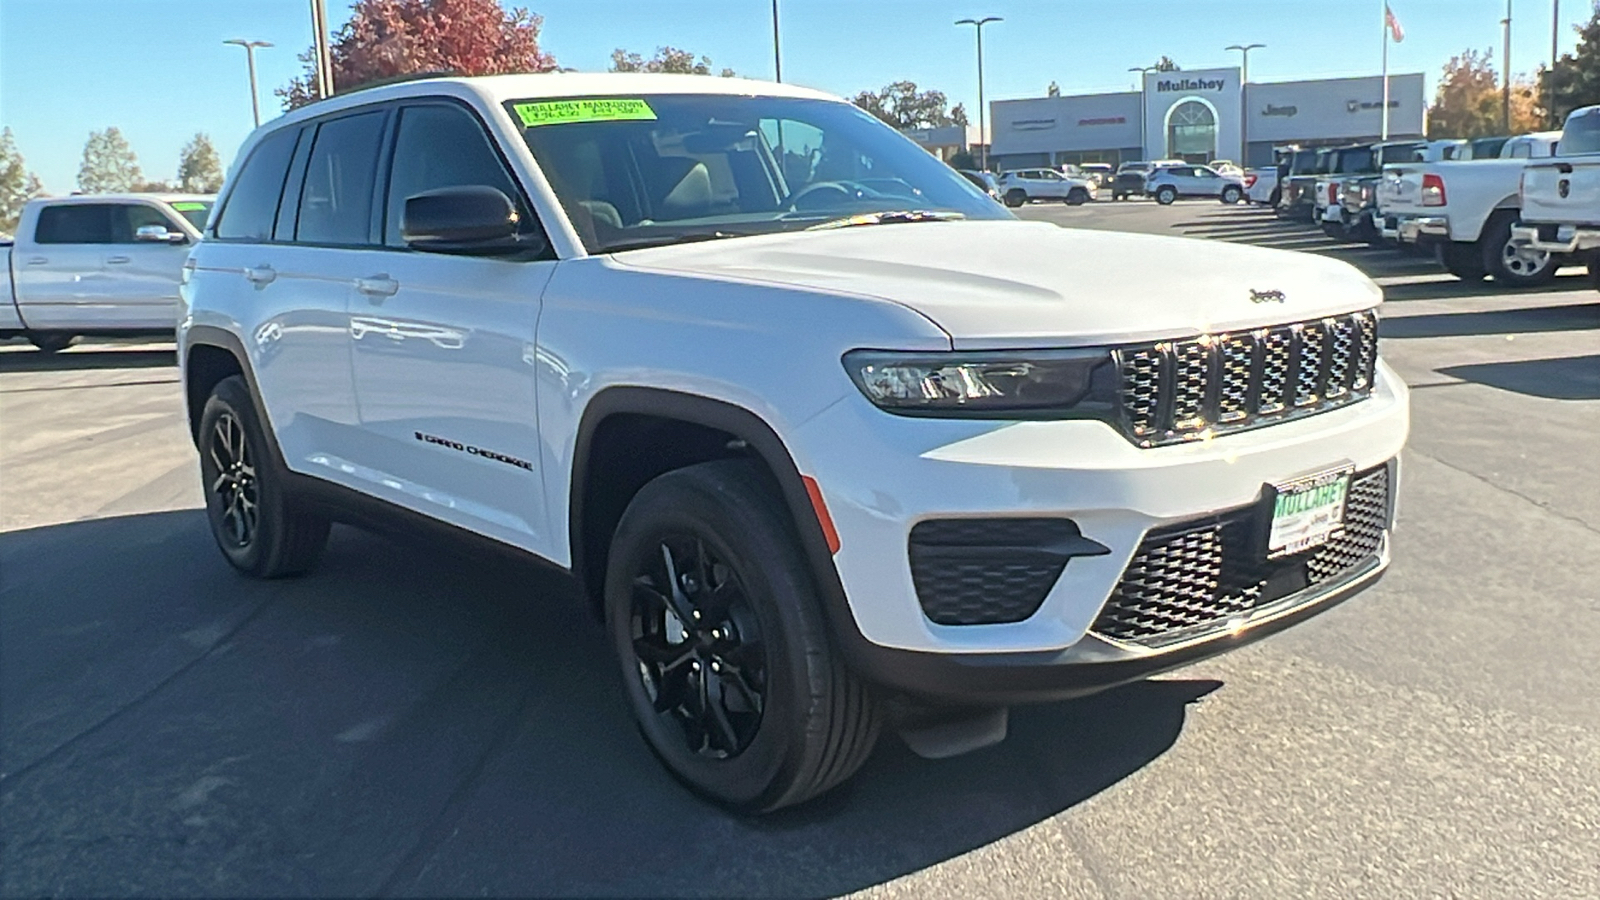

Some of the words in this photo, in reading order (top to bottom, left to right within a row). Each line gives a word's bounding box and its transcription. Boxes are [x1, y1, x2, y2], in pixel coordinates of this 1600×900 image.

[1157, 78, 1224, 92] Mullahey
[1249, 288, 1286, 304] Jeep
[1274, 480, 1344, 519] MULLAHEY
